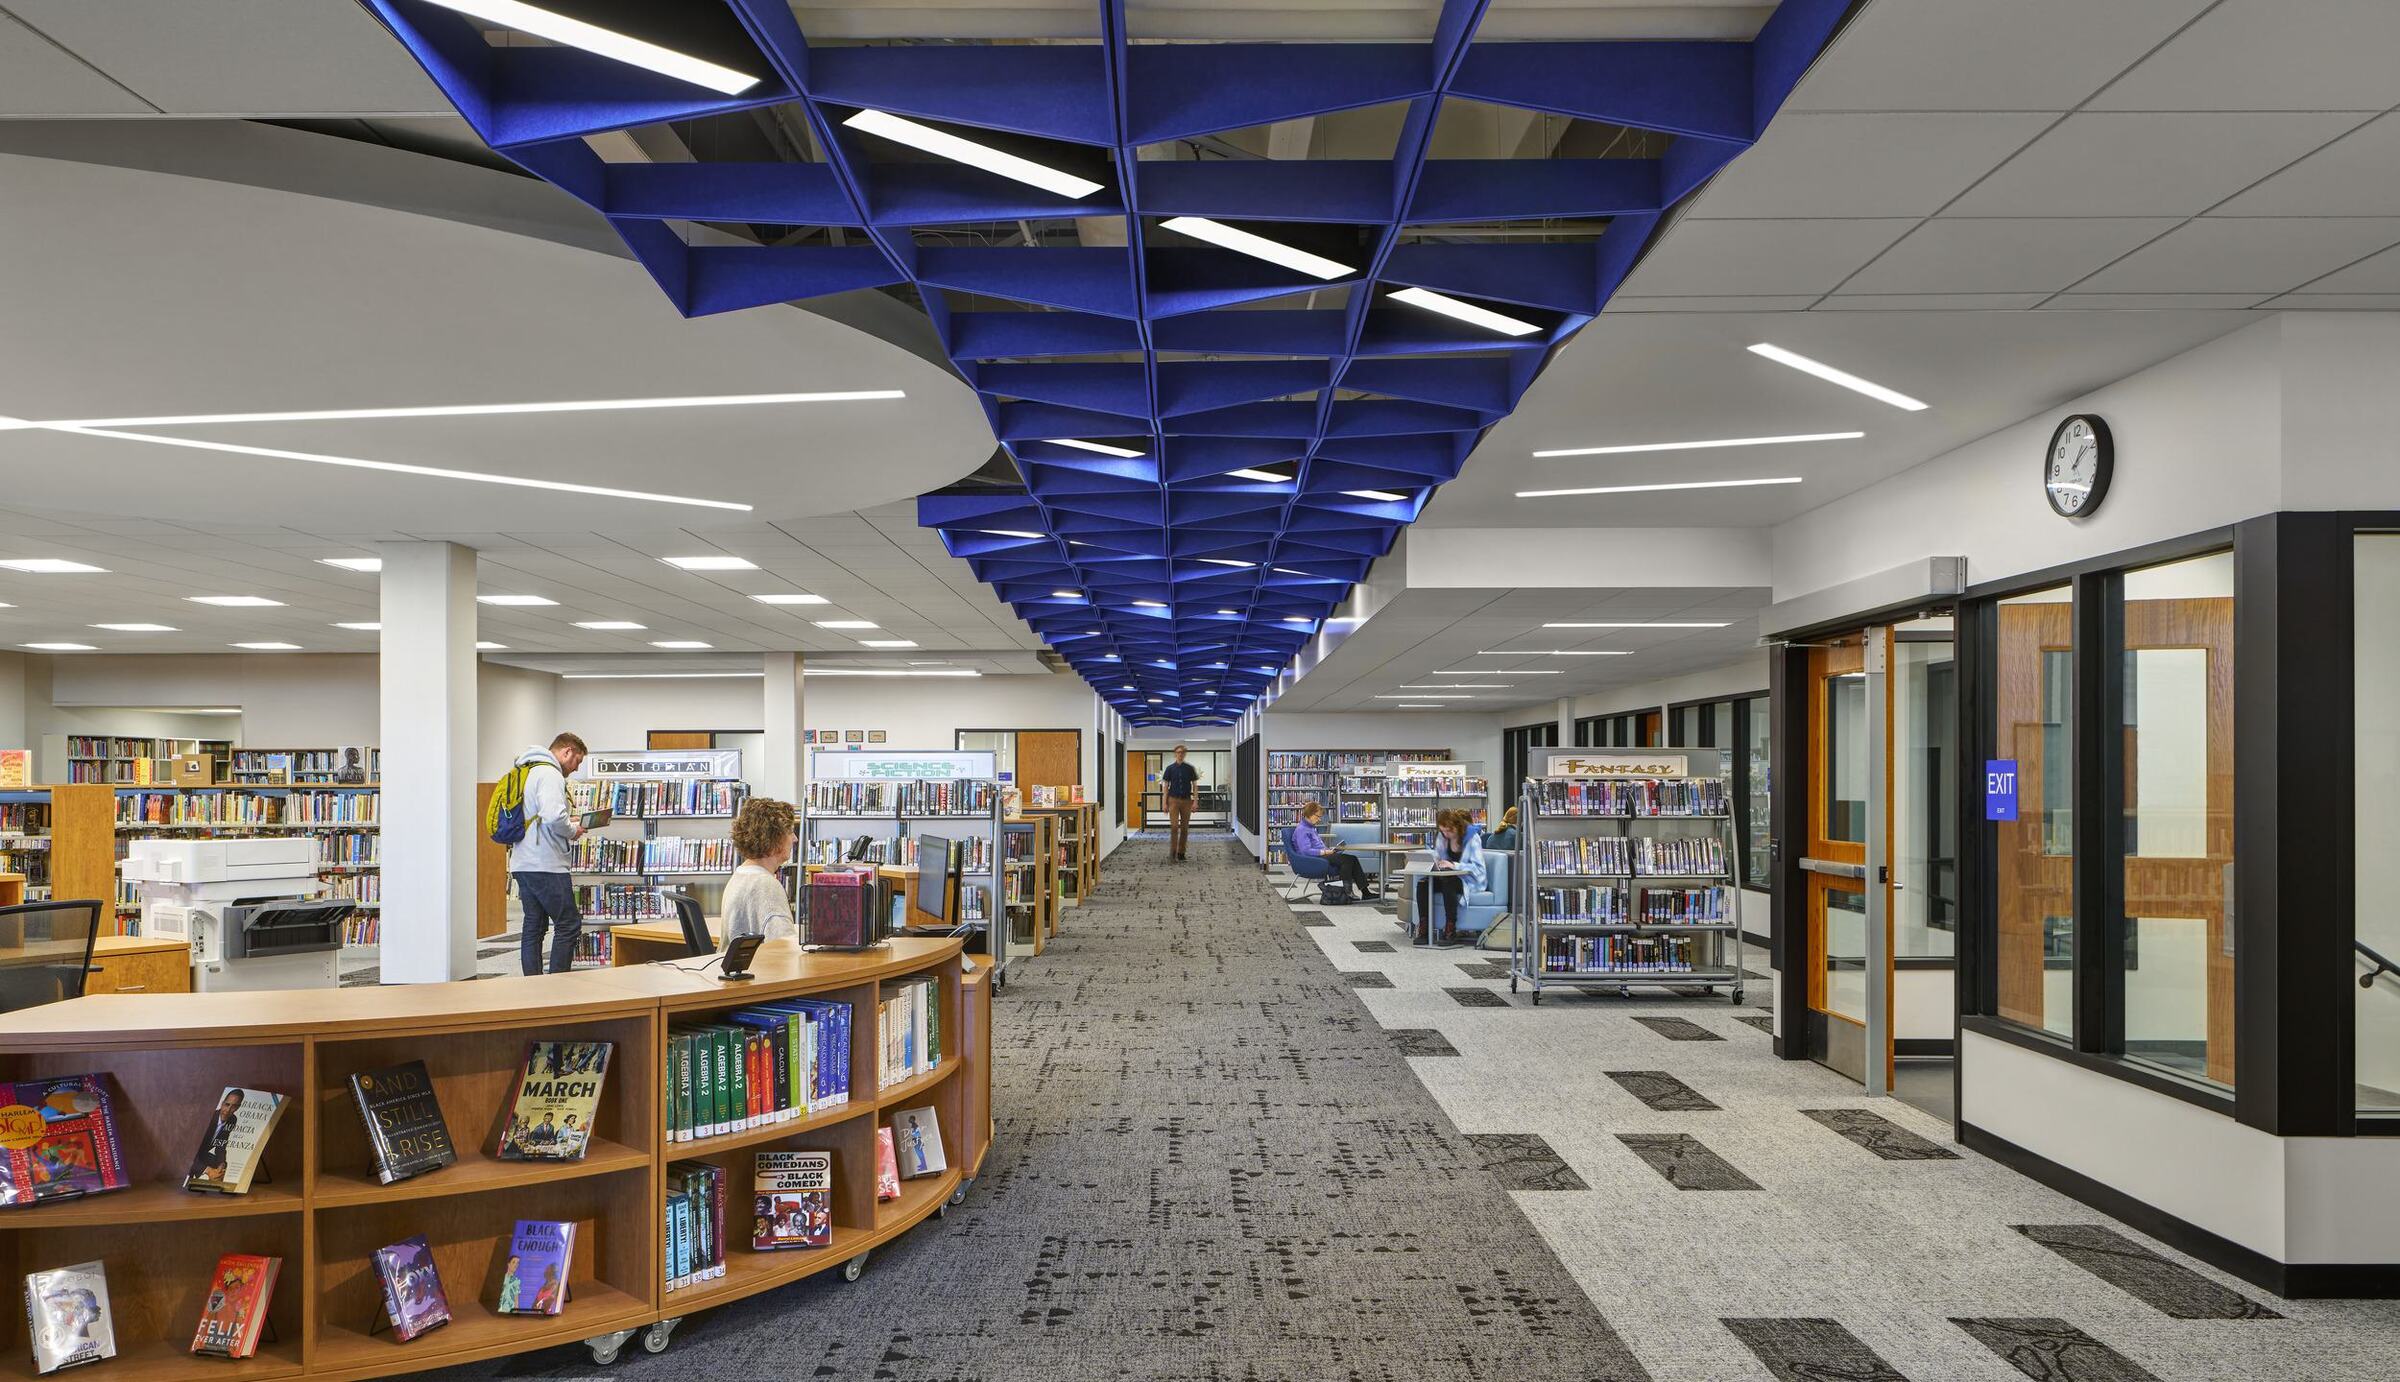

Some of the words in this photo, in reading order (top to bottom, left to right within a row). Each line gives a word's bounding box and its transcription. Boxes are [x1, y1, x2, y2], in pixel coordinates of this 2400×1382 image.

[2073, 424, 2081, 438] 12
[2066, 432, 2071, 444] 11
[2058, 447, 2066, 460] 10
[2054, 465, 2061, 477] 9
[2064, 493, 2070, 505] 7
[2071, 495, 2078, 508] 6
[600, 763, 709, 772] DYSTOPIAN
[867, 762, 955, 770] SCIENCE
[1402, 766, 1461, 775] FANTASY
[1558, 759, 1675, 775] FANTASY
[1988, 773, 2015, 795] EXIT
[700, 1049, 709, 1089] ALGEBRA
[717, 1045, 726, 1085] ALGEBRA
[734, 1043, 742, 1083] ALGEBRA
[680, 1050, 689, 1089] ALGEBRA
[375, 1072, 417, 1097] AND
[522, 1081, 597, 1098] MARCH
[241, 1100, 273, 1112] BARACK
[0, 1109, 36, 1118] HARLEM
[239, 1111, 268, 1121] OBAMA
[380, 1101, 433, 1129] STILL
[223, 1123, 256, 1135] AUDACIA
[703, 1127, 708, 1135] 3
[683, 1132, 687, 1140] 2
[212, 1139, 254, 1151] ESPERANZA
[399, 1129, 445, 1157] RISE
[757, 1161, 824, 1169] COMEDIANS
[777, 1180, 824, 1188] COMEDY
[526, 1224, 556, 1237] BLACK
[517, 1240, 559, 1253] ENOUGH
[695, 1273, 701, 1282] 32
[708, 1271, 714, 1279] 33
[680, 1278, 688, 1286] 31
[197, 1318, 245, 1338] FELIX
[194, 1334, 214, 1344] EVER
[216, 1338, 240, 1347] AFTER
